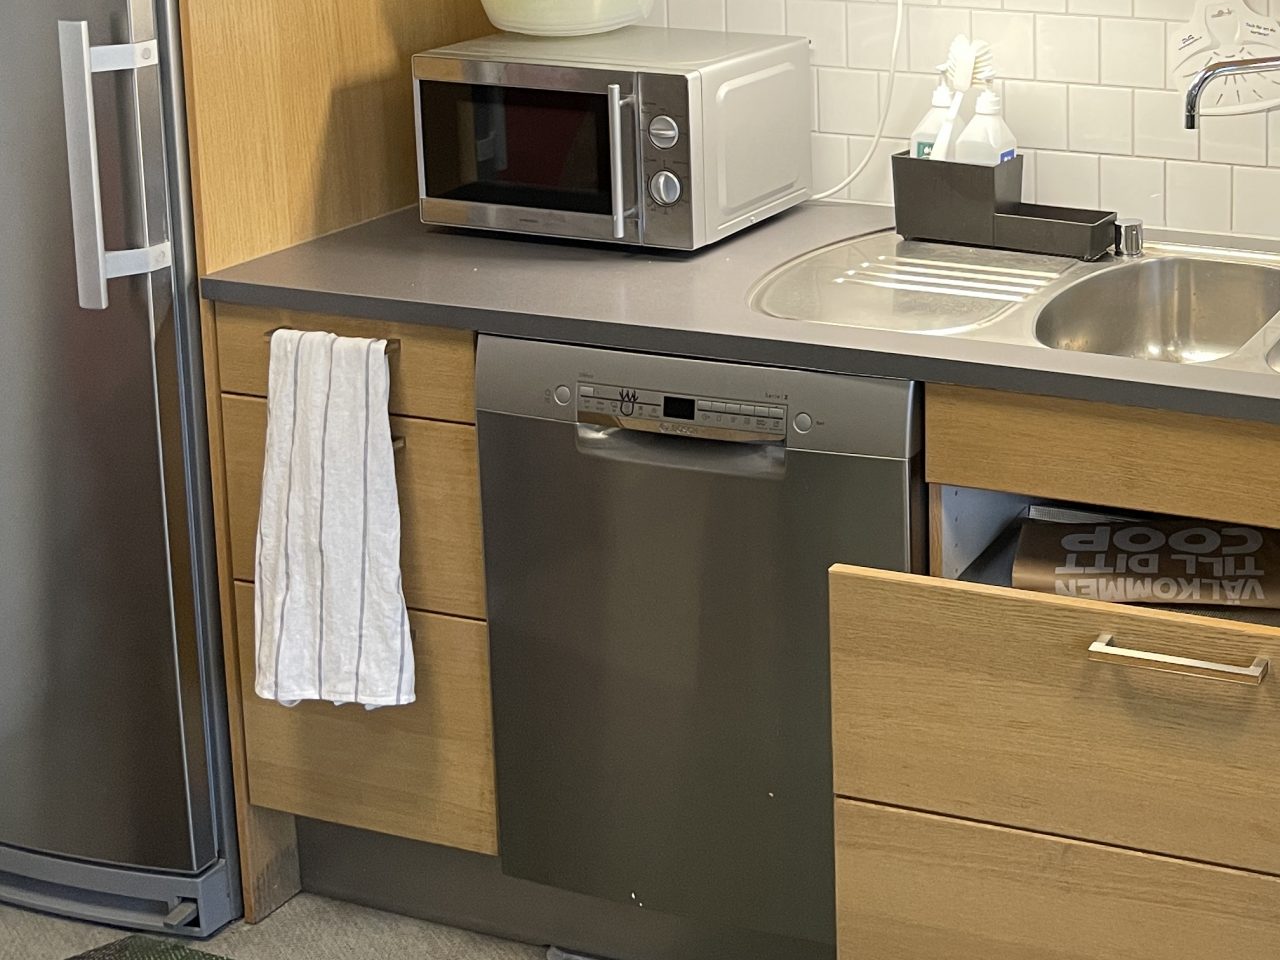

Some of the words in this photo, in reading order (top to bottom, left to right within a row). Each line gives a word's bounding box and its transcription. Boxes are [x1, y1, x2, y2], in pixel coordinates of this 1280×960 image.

[1060, 525, 1264, 555] COOP
[1054, 553, 1160, 575] DITT
[1170, 553, 1265, 577] TILL
[1054, 576, 1265, 606] VÄLKOMMEN
